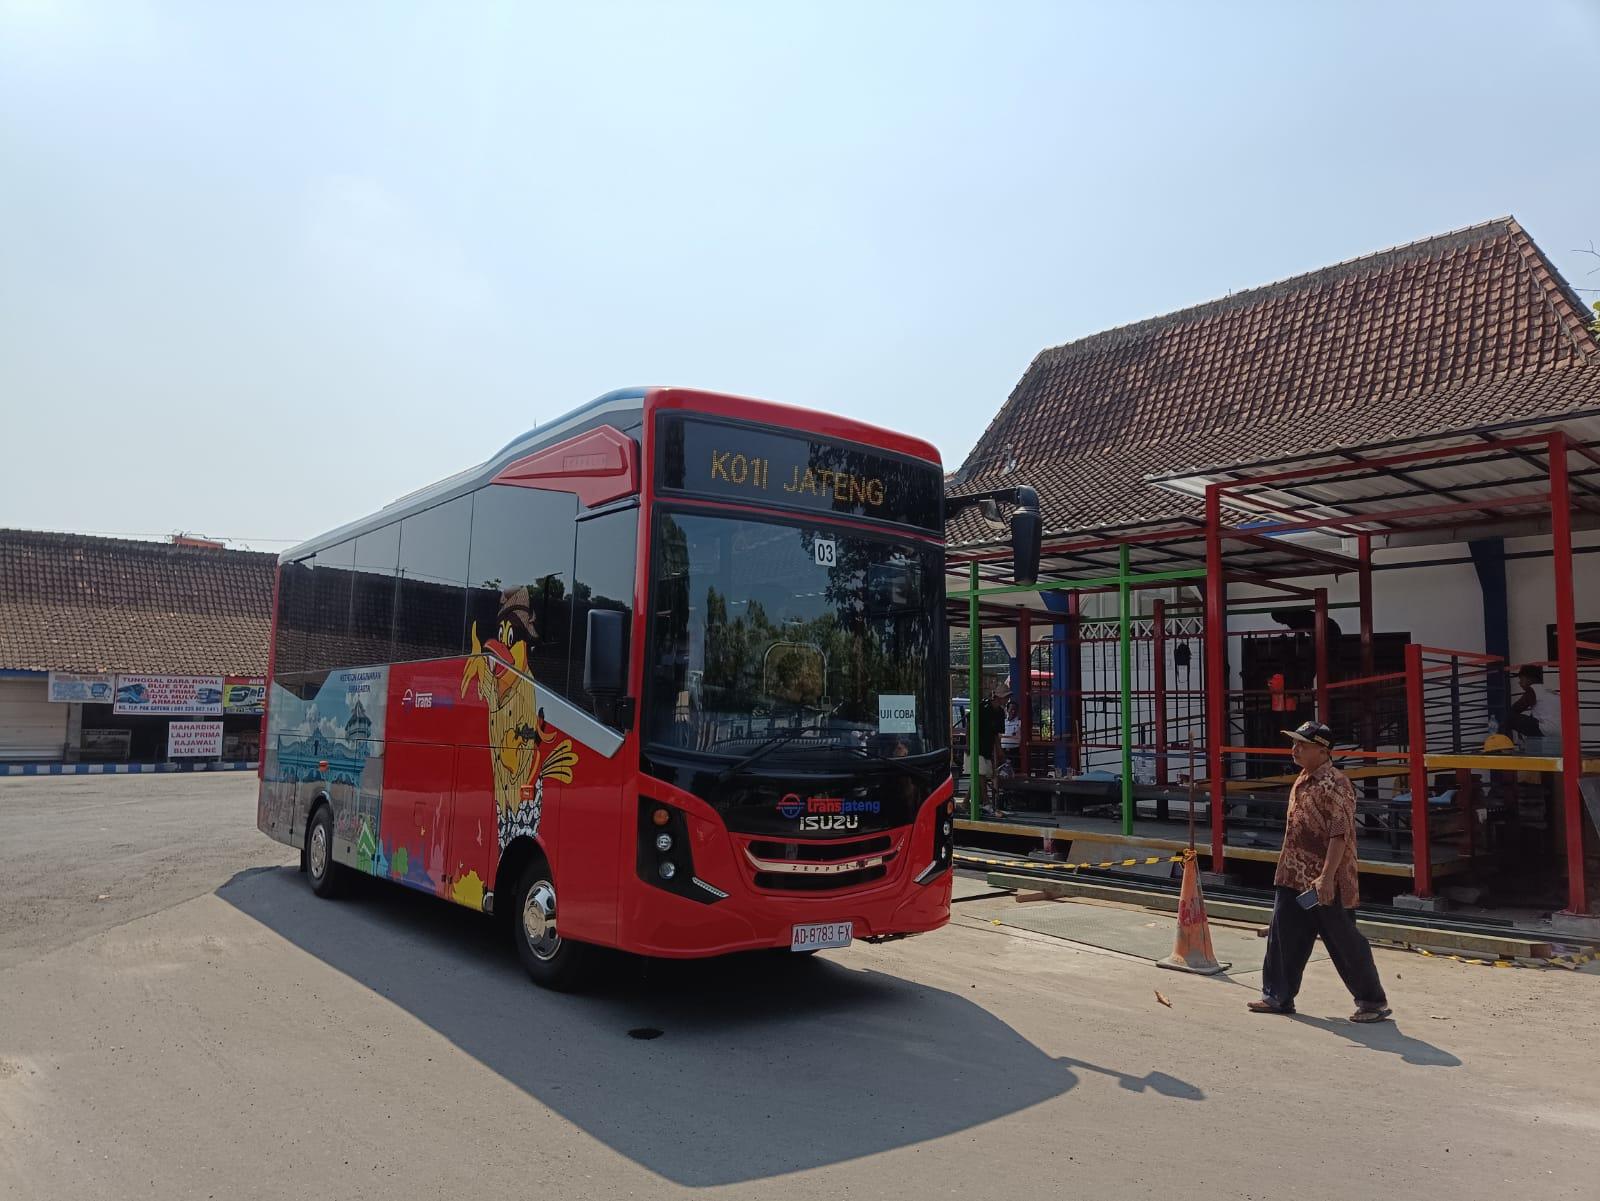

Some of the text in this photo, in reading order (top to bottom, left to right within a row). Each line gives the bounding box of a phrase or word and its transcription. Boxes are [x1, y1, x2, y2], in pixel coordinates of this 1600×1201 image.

[817, 543, 834, 563] 03
[880, 709, 915, 719] UJI COBA
[799, 814, 858, 831] ISUZU
[793, 924, 850, 945] AD 8783 FX
